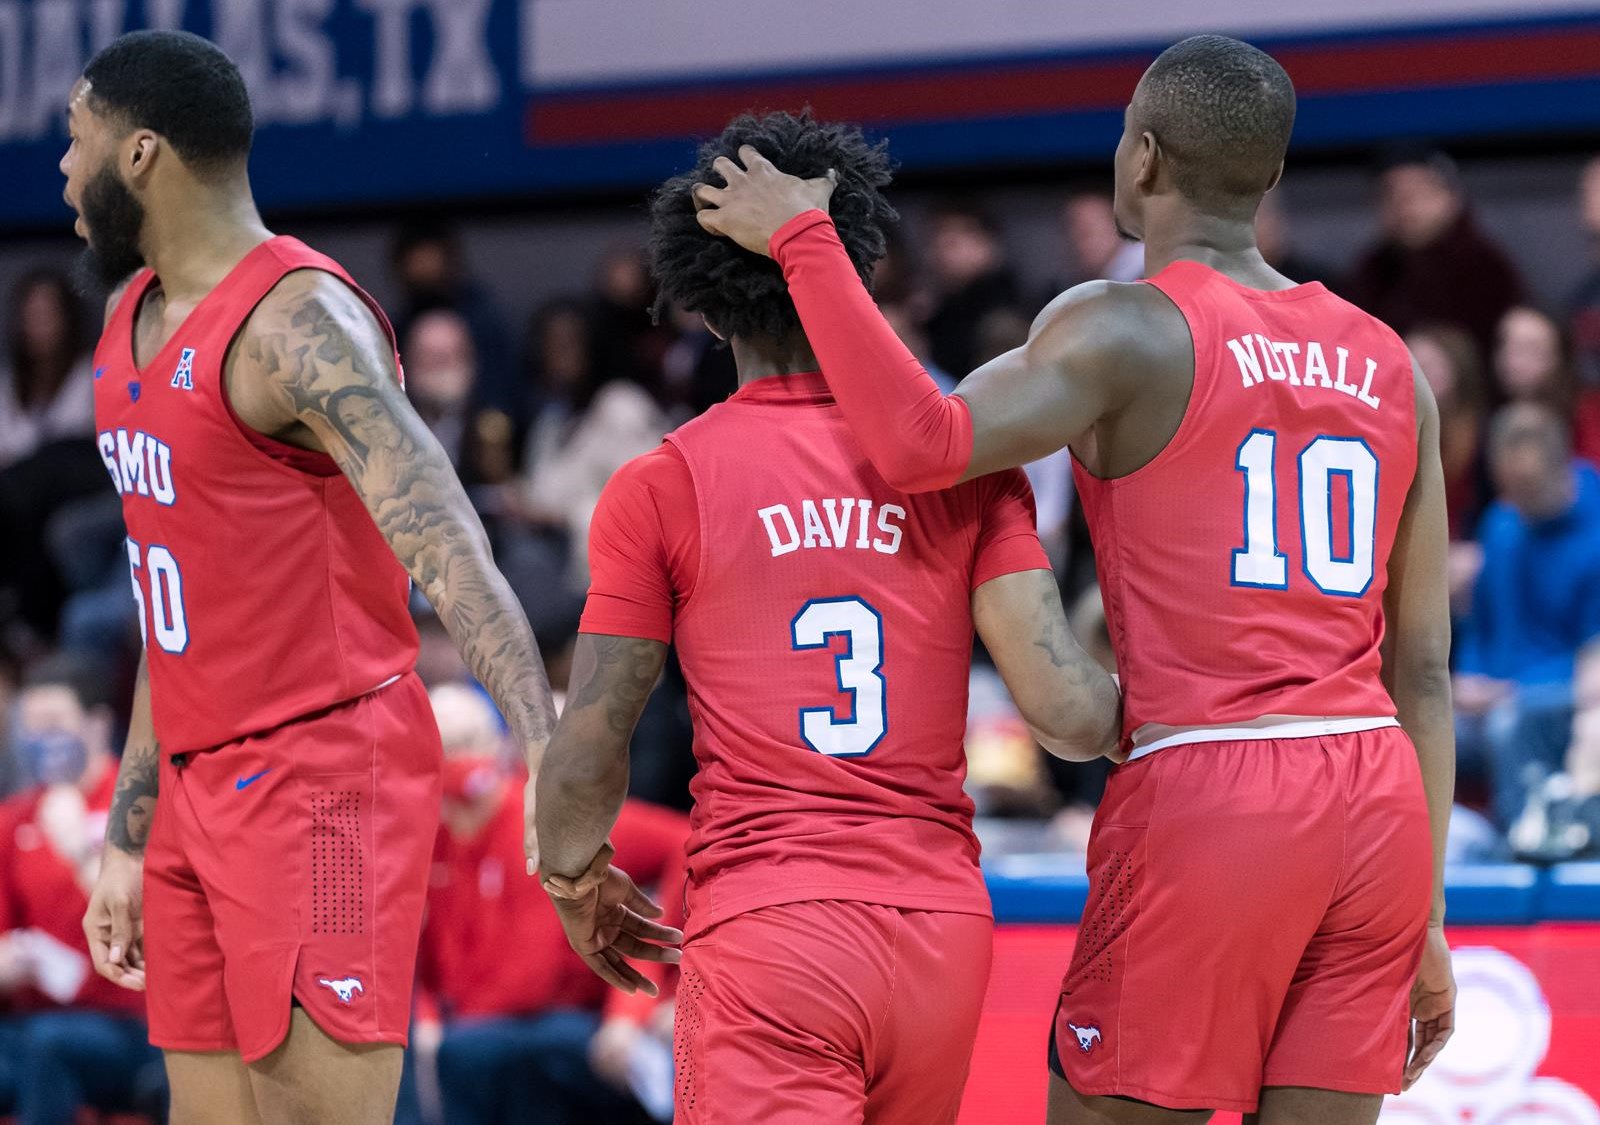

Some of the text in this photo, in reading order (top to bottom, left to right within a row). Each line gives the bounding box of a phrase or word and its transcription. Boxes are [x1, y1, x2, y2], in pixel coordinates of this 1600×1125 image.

[0, 0, 499, 137] AAS, TX
[97, 427, 176, 506] SMU
[757, 497, 906, 557] DAVIS
[1230, 426, 1380, 598] 10
[790, 595, 888, 758] 3
